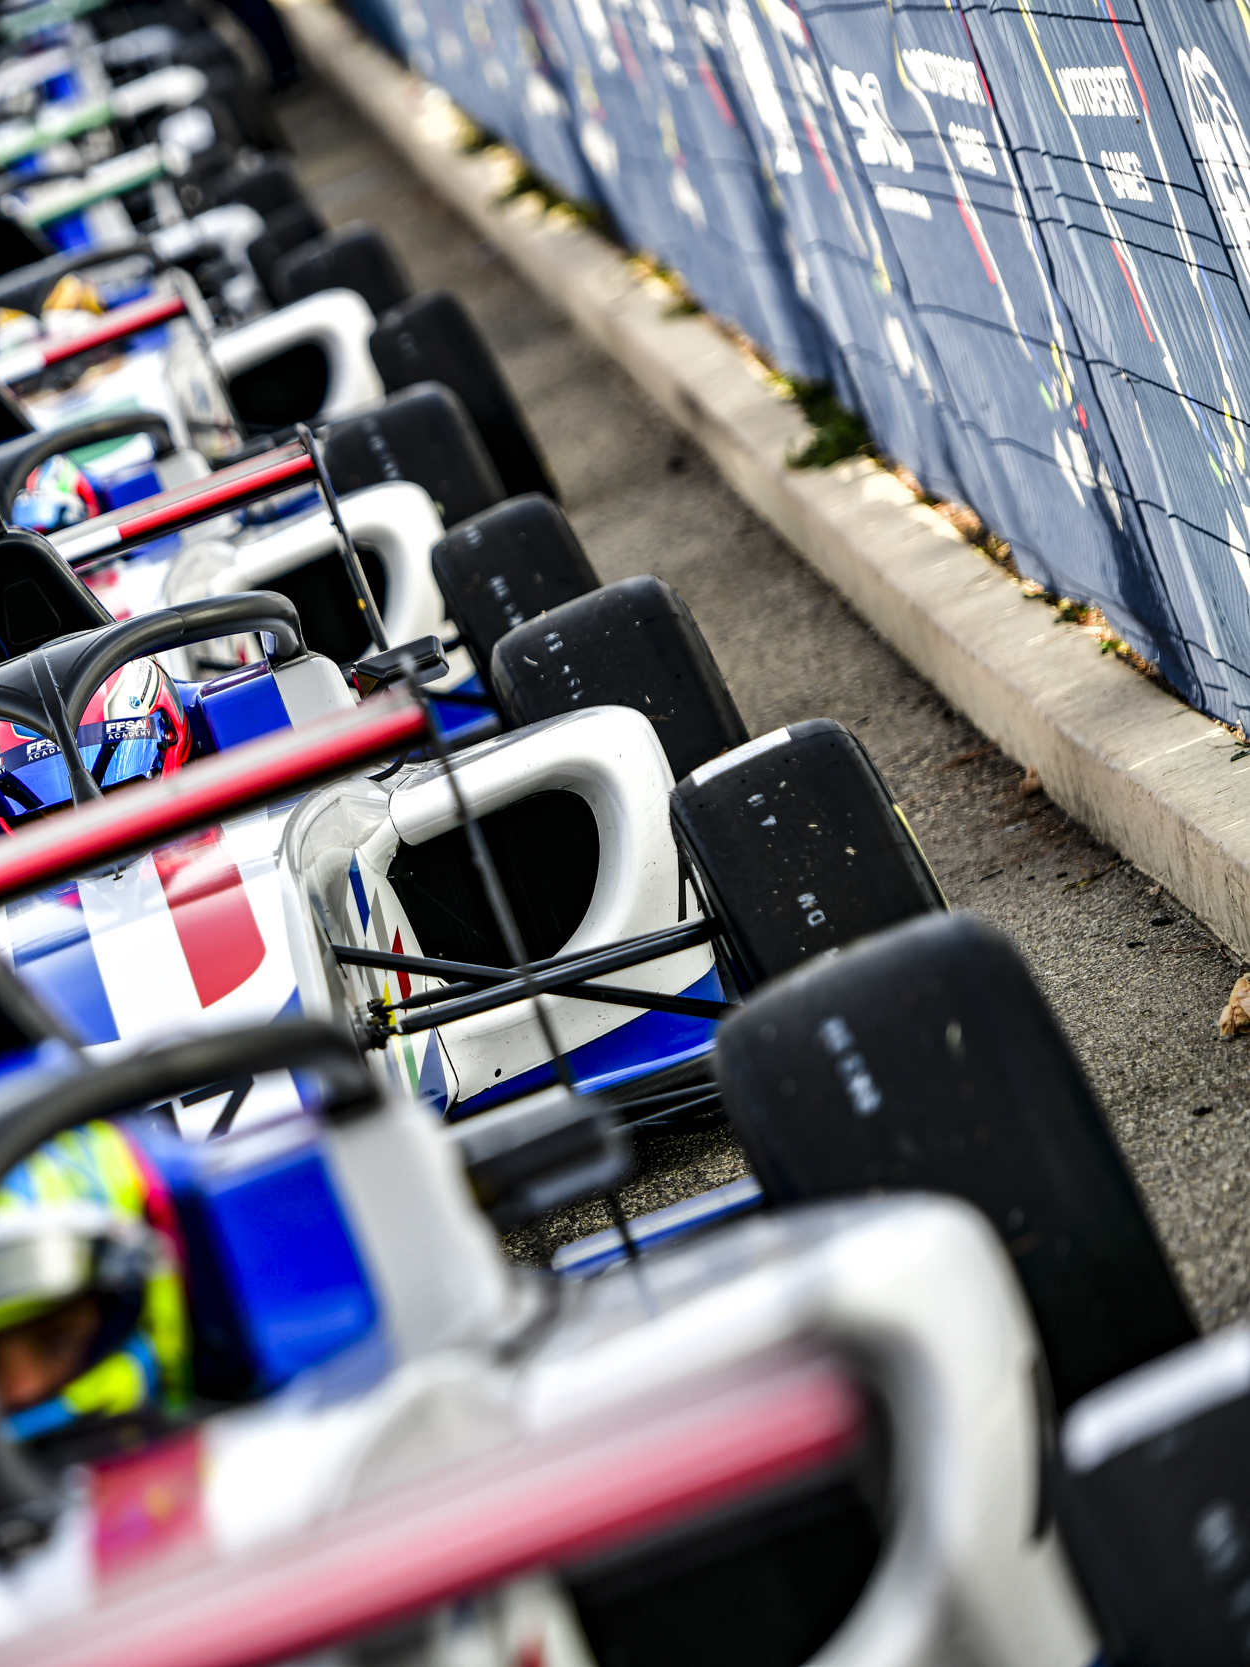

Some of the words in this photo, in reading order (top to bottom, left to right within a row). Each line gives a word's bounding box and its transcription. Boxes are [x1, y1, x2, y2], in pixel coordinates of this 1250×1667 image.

[1056, 65, 1139, 117] MOTORSPORT
[1100, 150, 1153, 203] GAMES
[108, 729, 151, 740] ACADEMY
